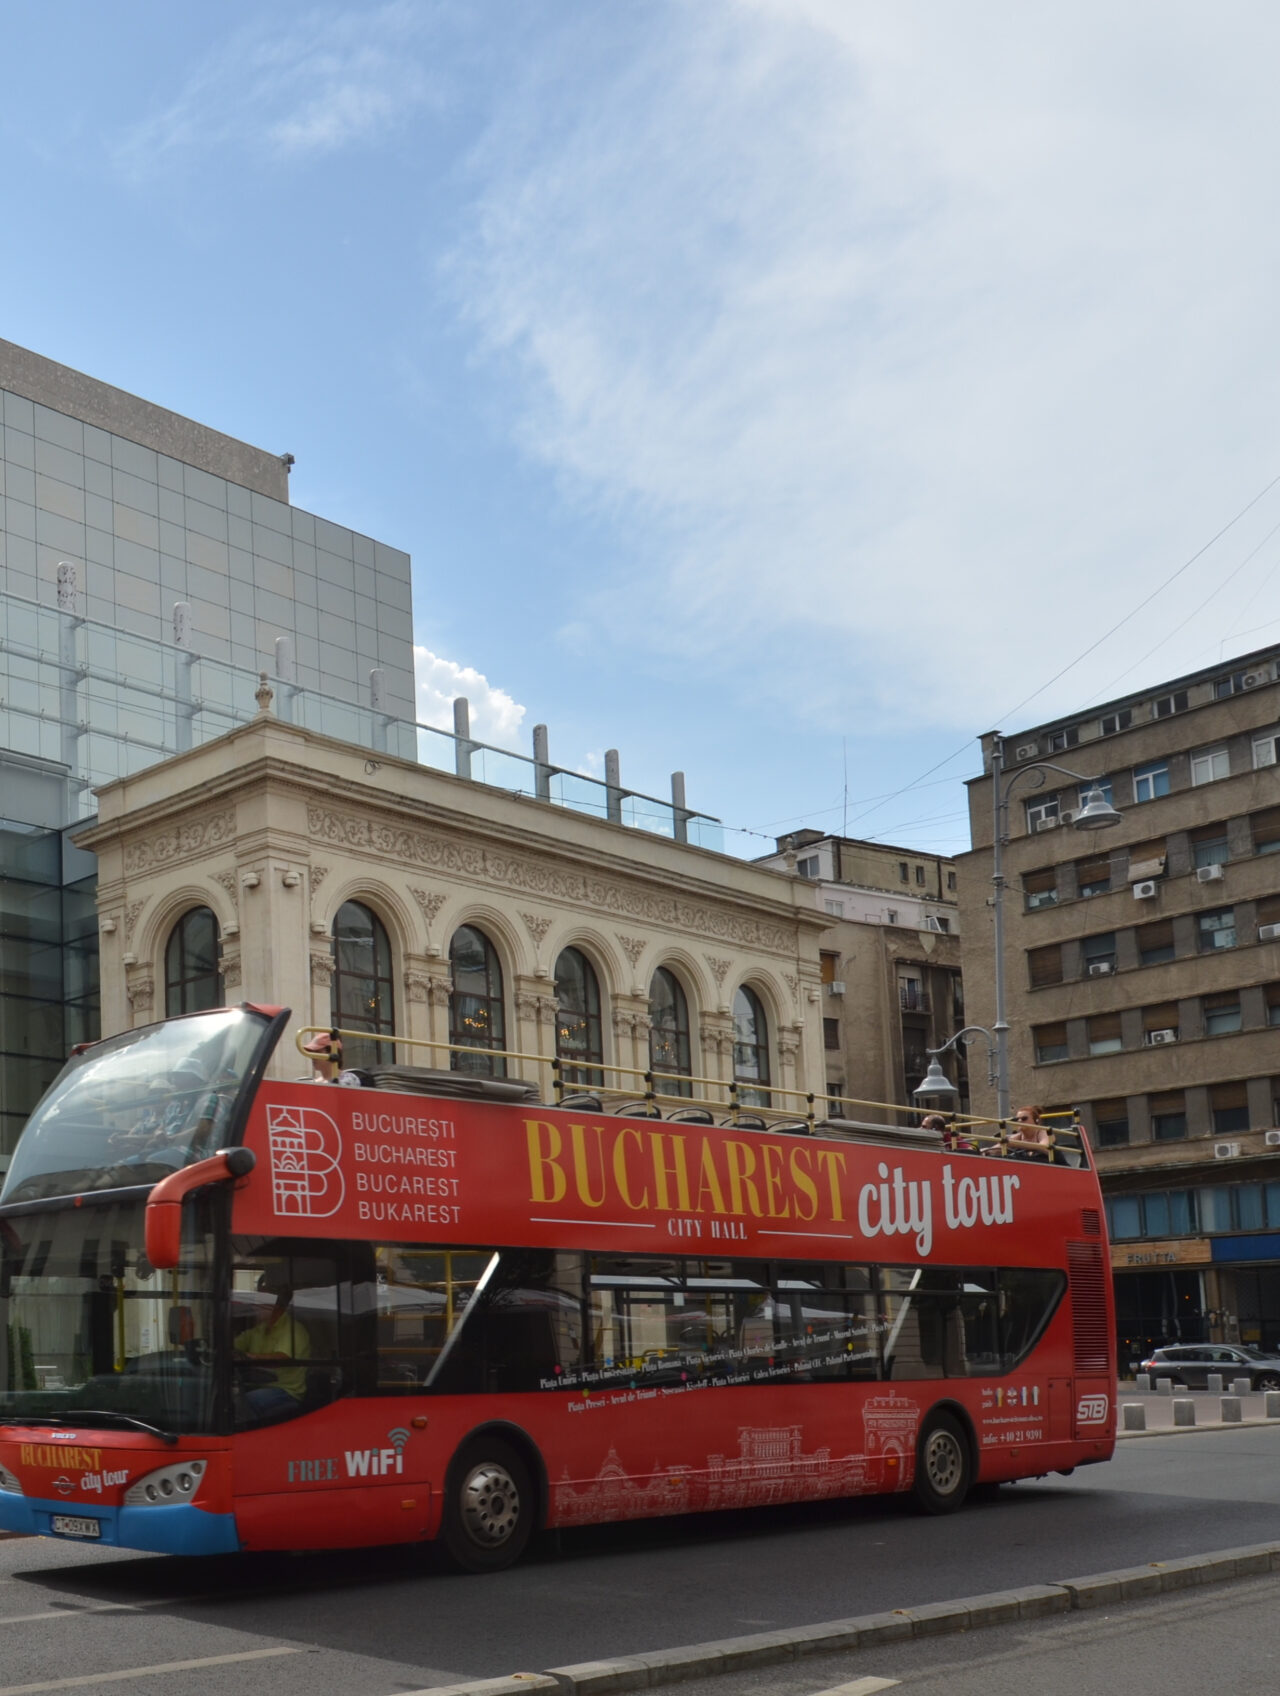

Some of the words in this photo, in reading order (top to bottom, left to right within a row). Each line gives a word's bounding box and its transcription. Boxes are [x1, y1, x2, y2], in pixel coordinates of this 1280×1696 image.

[352, 1112, 456, 1141] BUCUREȘTI
[354, 1143, 457, 1168] BUCHAREST
[522, 1119, 847, 1222] BUCHAREST
[356, 1173, 459, 1196] BUCAREST
[358, 1201, 461, 1224] BUKAREST
[858, 1162, 932, 1257] city
[942, 1164, 1020, 1229] tour
[667, 1218, 702, 1238] CITY
[711, 1220, 748, 1240] HALL
[1076, 1399, 1105, 1419] STB
[21, 1444, 102, 1471] BUCHAREST
[288, 1458, 339, 1482] FREE
[344, 1447, 403, 1477] WiFi
[81, 1472, 102, 1493] city
[103, 1470, 129, 1486] tour
